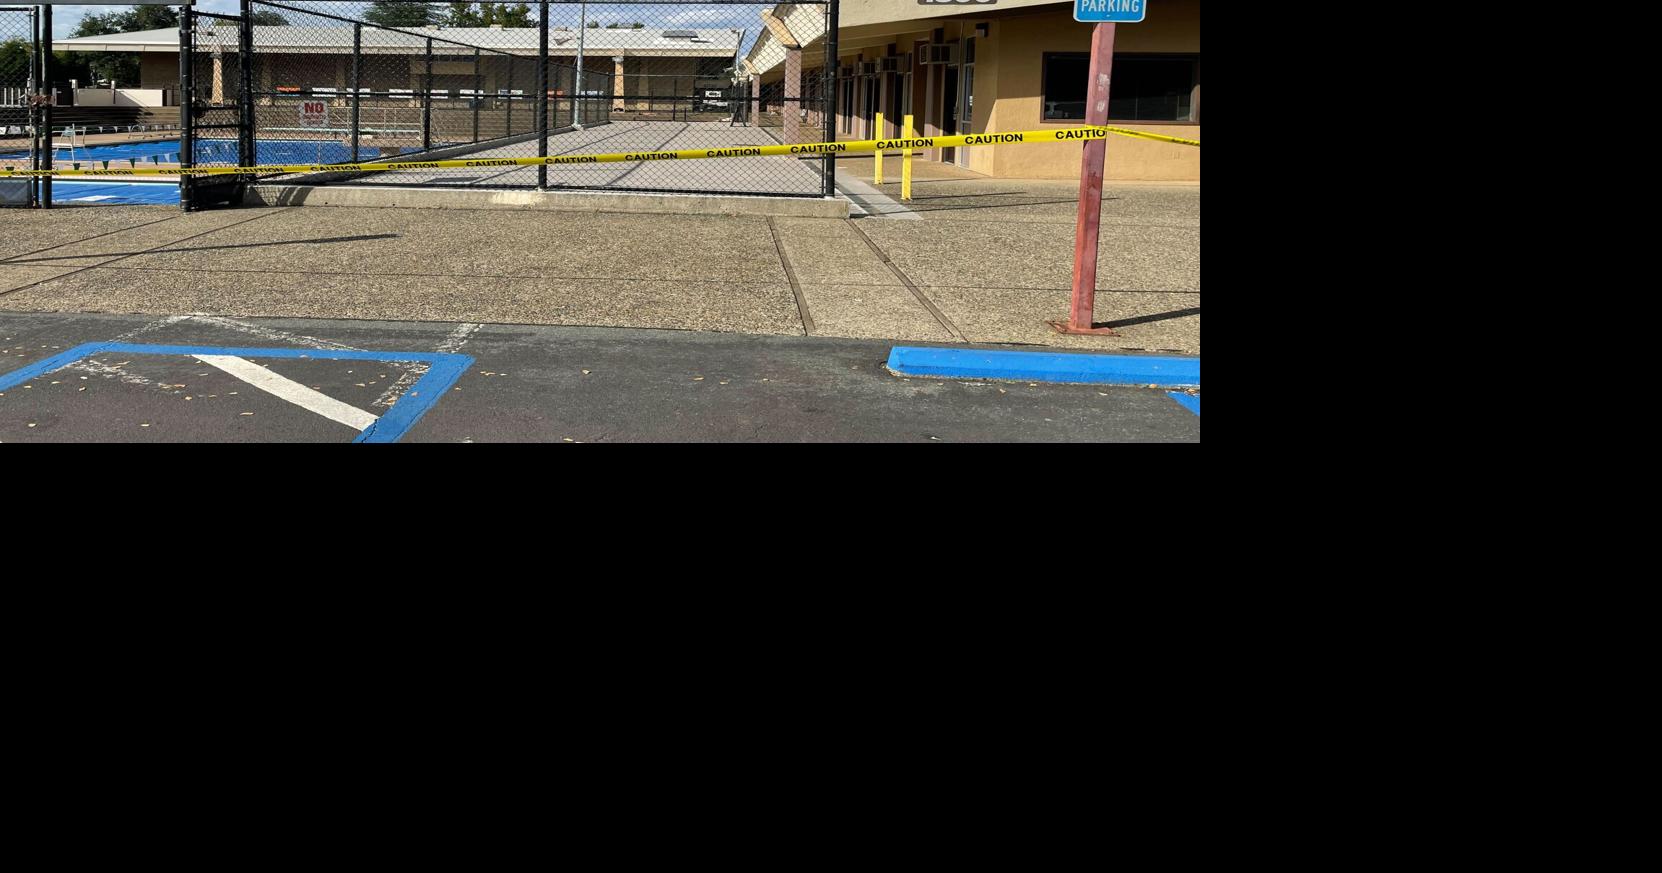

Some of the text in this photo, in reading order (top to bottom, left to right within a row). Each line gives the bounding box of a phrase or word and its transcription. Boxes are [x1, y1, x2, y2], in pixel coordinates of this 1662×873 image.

[1081, 0, 1140, 12] PARKING
[304, 102, 324, 113] NO
[545, 156, 597, 165] CAUTION
[624, 152, 678, 161] CAUTION
[706, 148, 761, 158] CAUTION
[790, 143, 846, 154] CAUTION
[876, 138, 934, 149] CAUTION
[964, 133, 1023, 145] CAUTION
[1055, 129, 1106, 139] CAUTIO
